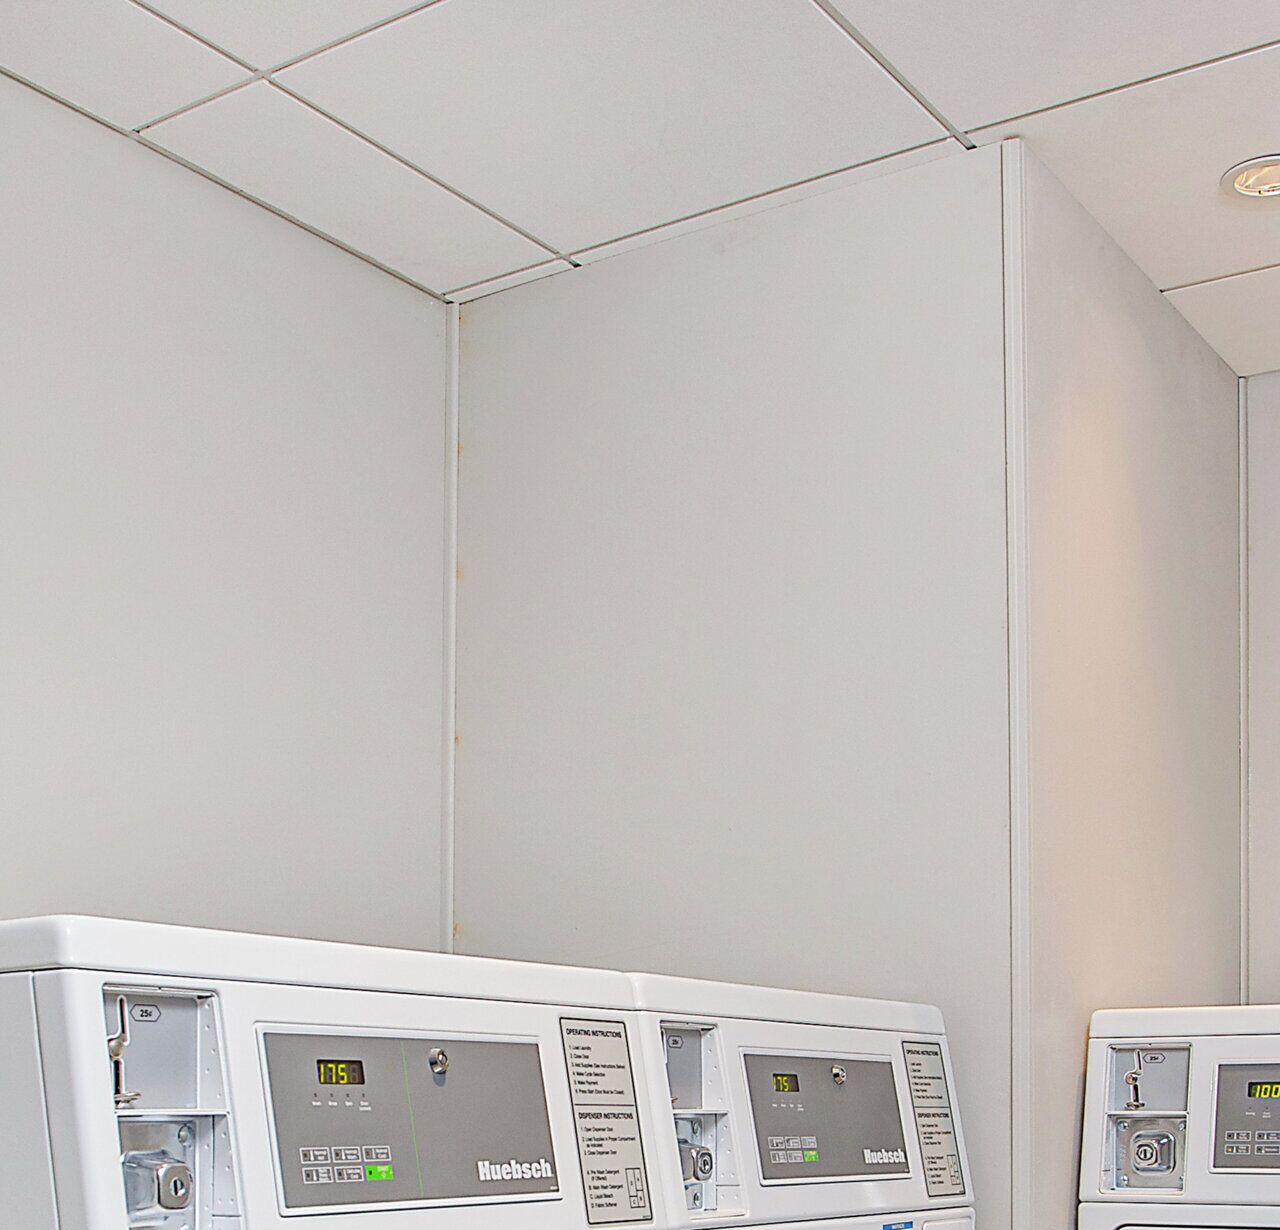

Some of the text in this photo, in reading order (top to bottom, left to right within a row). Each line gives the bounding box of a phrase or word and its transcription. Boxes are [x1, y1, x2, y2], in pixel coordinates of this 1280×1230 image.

[566, 1028, 591, 1036] OPERATING
[320, 1063, 348, 1084] 175
[773, 1076, 789, 1092] 175
[604, 1112, 633, 1120] INSTRUCTIONS
[863, 1148, 906, 1164] Huebsch
[477, 1158, 552, 1181] Huebsch
